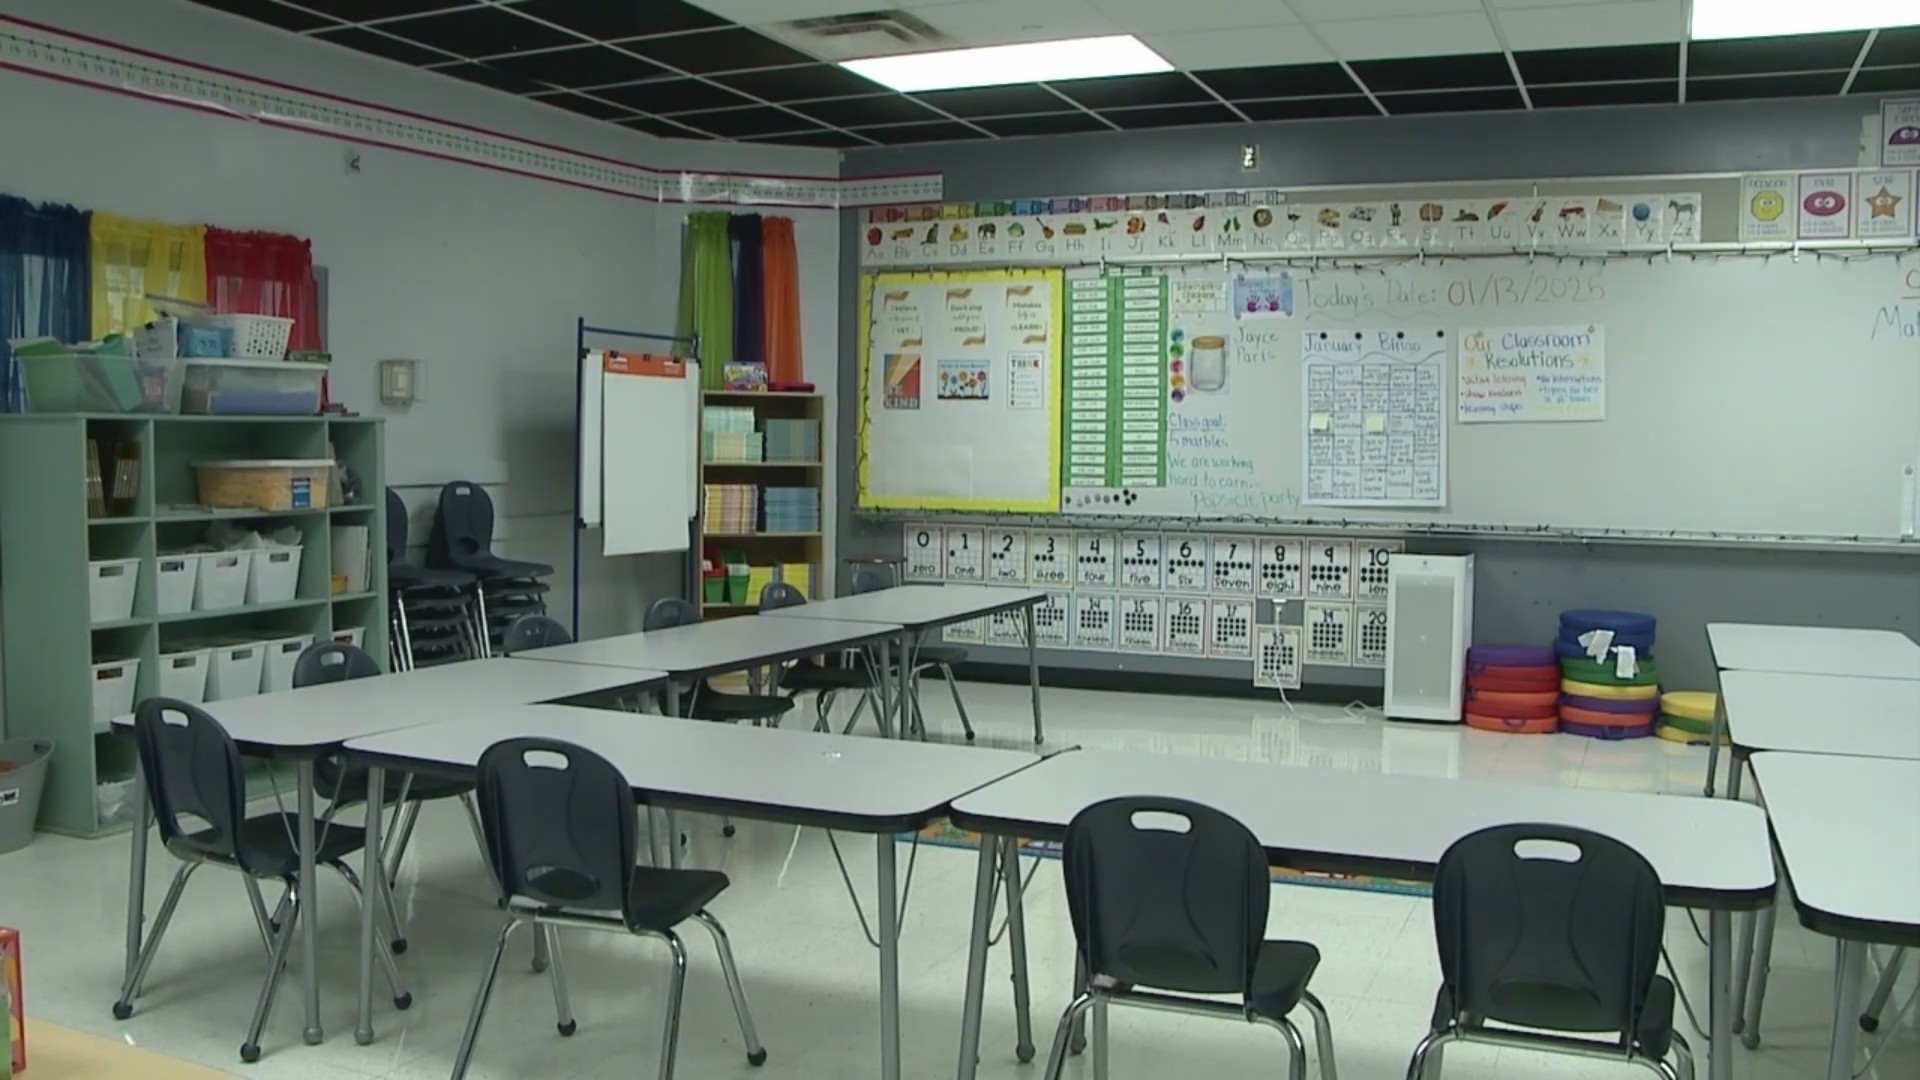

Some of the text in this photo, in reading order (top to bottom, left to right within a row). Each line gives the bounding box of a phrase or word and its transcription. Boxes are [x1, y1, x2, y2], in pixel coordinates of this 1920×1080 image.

[1298, 270, 1605, 310] Today's Date: 01/13/2025
[1236, 326, 1278, 348] Jayce
[1304, 332, 1362, 356] January
[1464, 332, 1590, 352] Our Classroom
[1484, 350, 1574, 370] Resolutions
[885, 396, 919, 409] KIND
[1167, 452, 1187, 469] We
[1168, 471, 1198, 488] hard
[917, 531, 929, 547] 0
[961, 533, 968, 549] 1
[1002, 534, 1013, 552] 2
[1047, 537, 1055, 553] 3
[1090, 538, 1100, 555] 4
[1136, 539, 1145, 557] 5
[1179, 541, 1192, 559] 6
[1229, 543, 1237, 560] 7
[1274, 545, 1285, 562] 8
[1324, 546, 1335, 563] 9
[1368, 548, 1389, 566] 10
[912, 565, 936, 573] zero
[955, 566, 975, 575] one
[998, 568, 1016, 577] two
[1036, 568, 1064, 579] three
[1084, 570, 1106, 582] four
[1130, 572, 1151, 584] five
[1178, 575, 1193, 585] six
[1215, 578, 1250, 590] seven
[1266, 579, 1294, 592] eight
[1316, 582, 1341, 591] nine
[1089, 599, 1100, 610] 14
[1134, 600, 1144, 613] 15
[1179, 603, 1192, 616] 16
[1226, 604, 1237, 618] 17
[1369, 612, 1387, 625] 20
